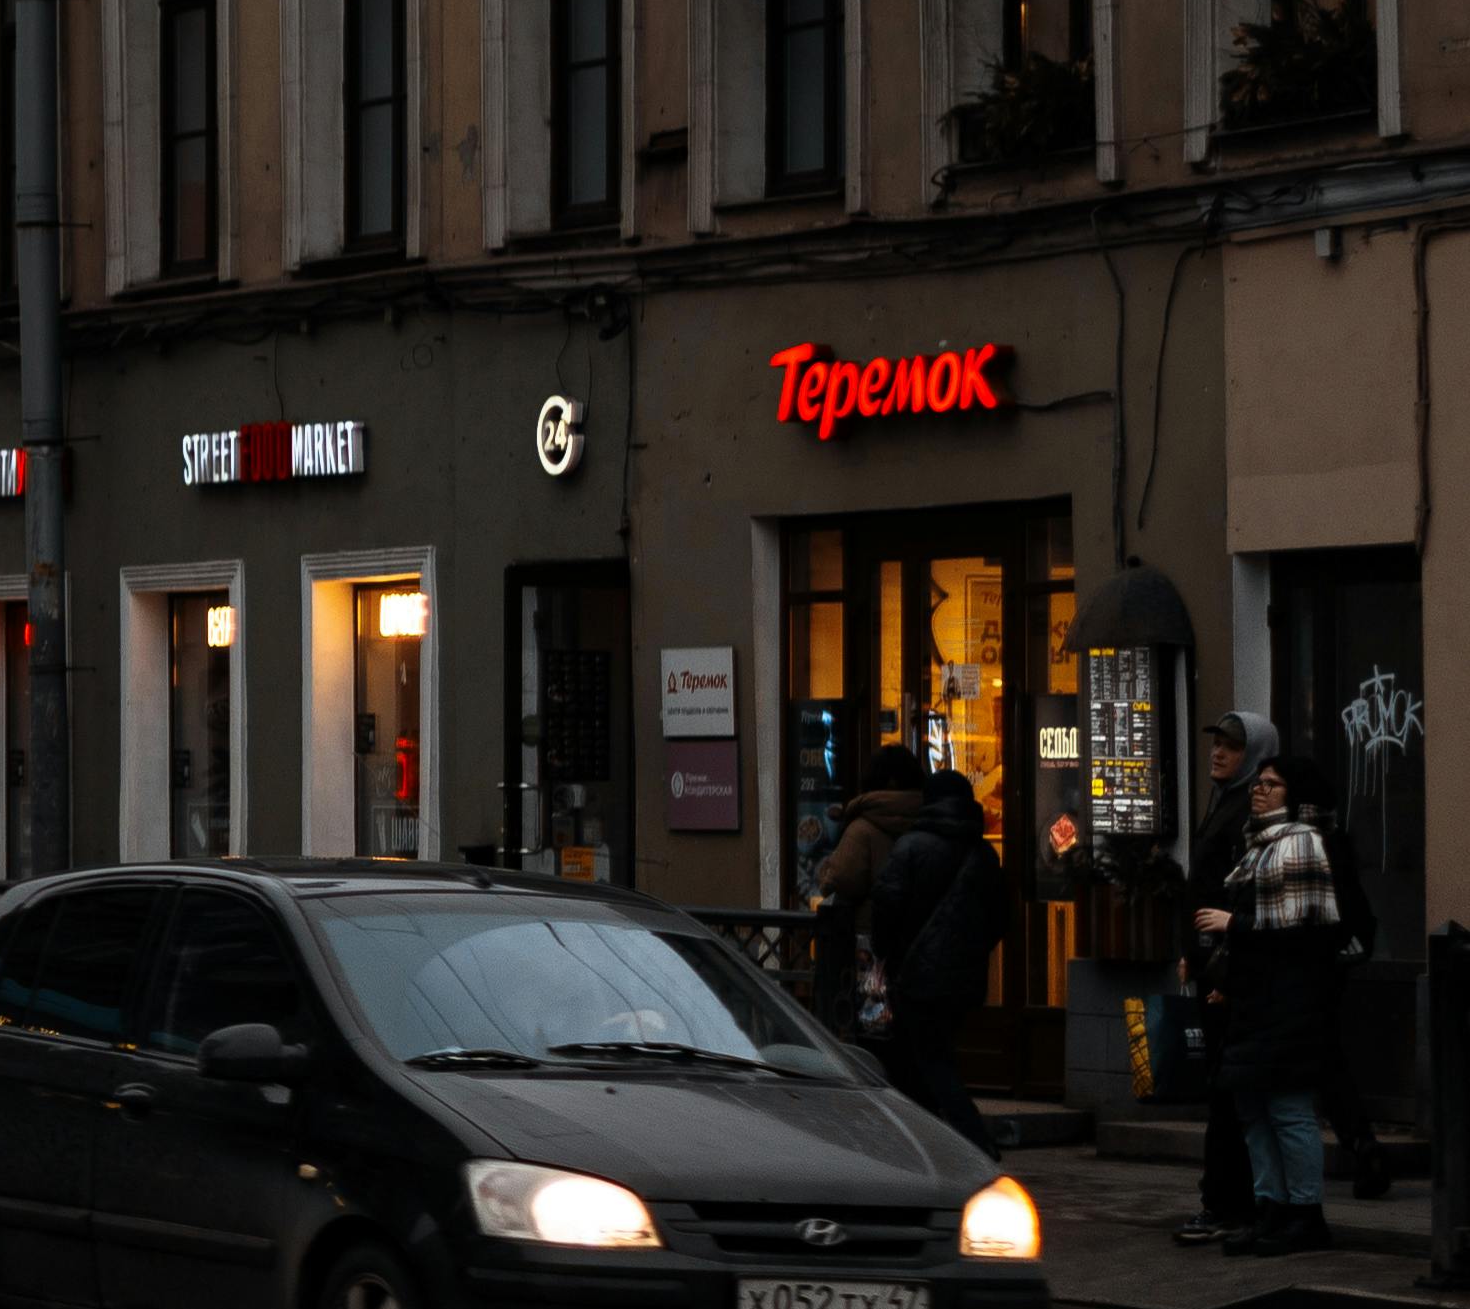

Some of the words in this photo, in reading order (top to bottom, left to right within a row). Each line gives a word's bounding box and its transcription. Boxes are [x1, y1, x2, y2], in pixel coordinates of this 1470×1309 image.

[769, 341, 999, 441] Теремок
[182, 430, 238, 486] STREET
[240, 420, 291, 483] FOOD
[291, 420, 356, 477] MARKET
[679, 670, 728, 694] Теремок
